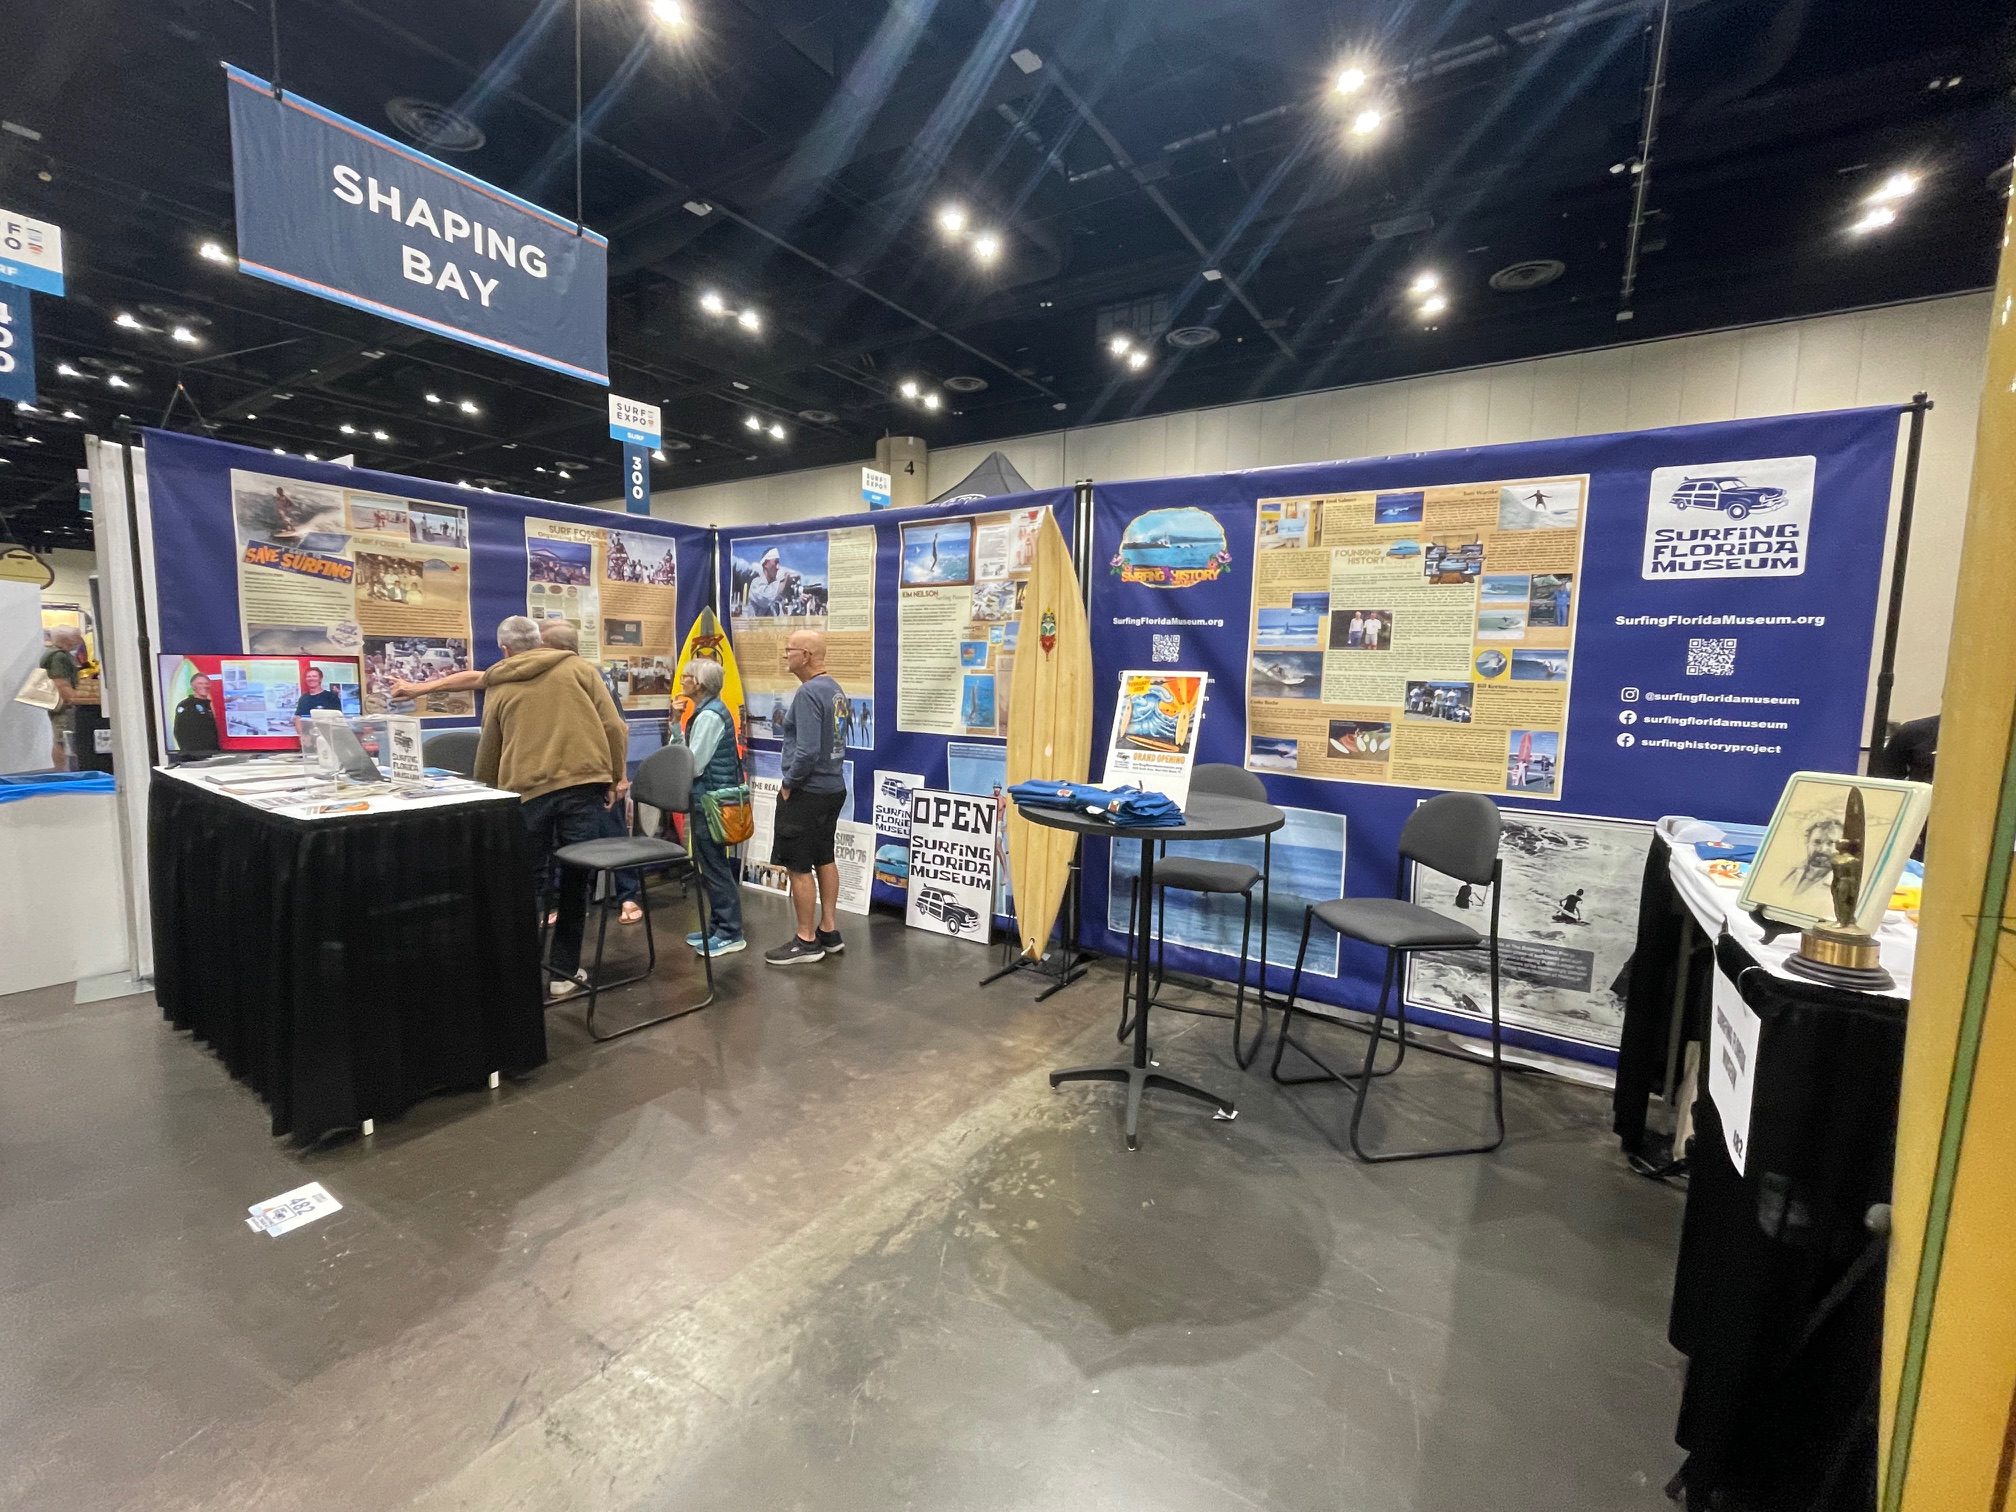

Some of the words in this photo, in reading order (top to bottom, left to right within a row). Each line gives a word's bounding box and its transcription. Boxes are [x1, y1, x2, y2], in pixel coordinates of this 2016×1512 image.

[333, 164, 548, 278] SHAPING
[402, 244, 499, 308] BAY
[616, 402, 647, 417] SURF
[616, 411, 647, 426] EXPO
[627, 431, 645, 441] SURF
[903, 461, 915, 476] 4
[631, 456, 644, 500] 300
[548, 525, 572, 535] SURF
[1334, 549, 1382, 558] FOUNDING
[1347, 556, 1386, 565] HISTORY
[245, 545, 280, 564] SAVE
[280, 552, 353, 580] SURFING
[1650, 556, 1799, 574] MUSEUM
[1112, 616, 1224, 628] SurfingFloridaMuseum.org
[1614, 614, 1826, 627] SurfingFloridaMuseum.org
[1644, 691, 1801, 706] @surfingfloridamuseum
[1643, 714, 1789, 730] surfingfloridamuseum
[1641, 737, 1782, 754] surfinghistoryproject
[875, 804, 912, 819] SURFiN
[913, 796, 996, 835] OPEN
[875, 822, 911, 836] MUSEU
[835, 832, 855, 847] SURF
[910, 864, 991, 891] MUSEUM
